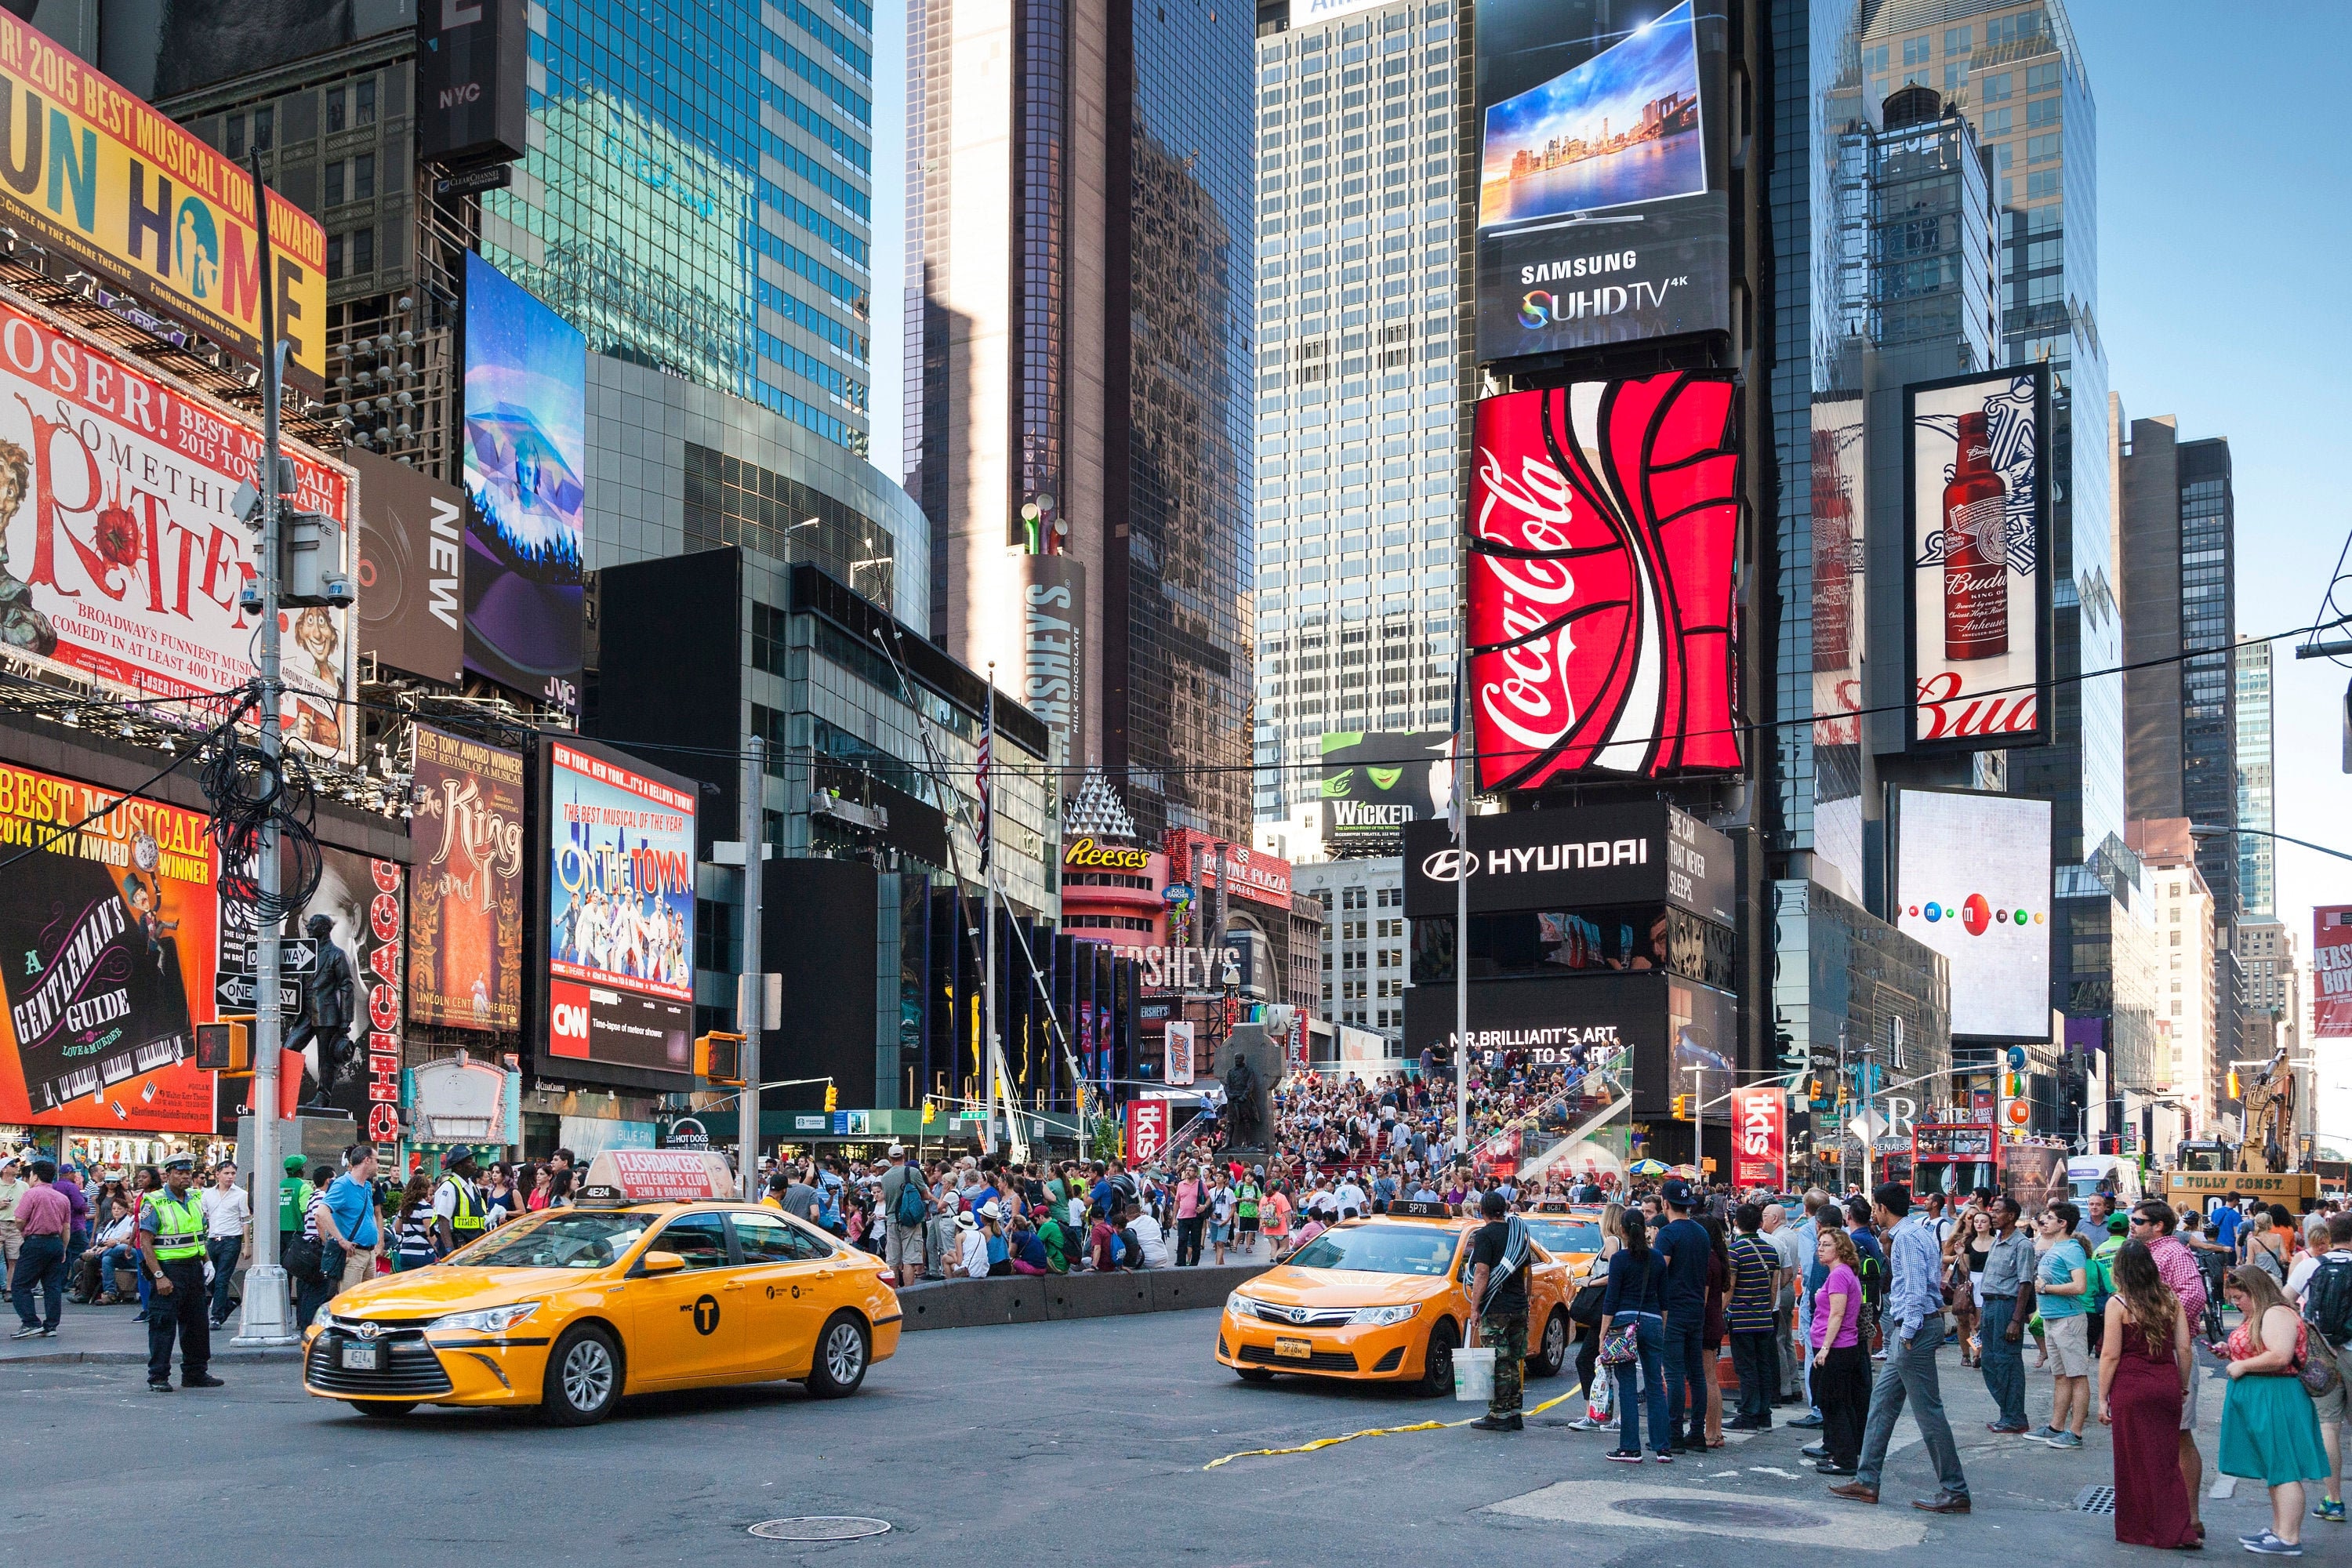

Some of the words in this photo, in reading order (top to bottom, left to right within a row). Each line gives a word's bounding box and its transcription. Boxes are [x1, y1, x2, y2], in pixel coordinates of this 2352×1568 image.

[440, 82, 481, 109] NYC
[29, 37, 78, 107] 2015
[84, 72, 132, 141] BEST
[136, 107, 220, 205] MUSICAL
[220, 160, 256, 224] TON
[267, 198, 322, 266] AWARD
[5, 198, 35, 225] CIRCLE
[38, 219, 45, 234] IN
[49, 227, 64, 242] THE
[65, 234, 96, 263] SQUARE
[98, 253, 132, 281] THEATRE
[1520, 250, 1637, 285] SAMSUNG
[150, 281, 241, 342] FUNHOMEBROADWAY.COM
[178, 403, 233, 449] BEST
[178, 428, 216, 463] 2015
[220, 449, 258, 485] TON
[429, 496, 459, 631] NEW
[1479, 445, 1577, 750] Coca-Cola
[1955, 601, 1976, 610] Brewed
[1976, 601, 1984, 609] by
[1948, 611, 1969, 619] Choicest
[52, 614, 108, 645] COMEDY
[111, 636, 125, 651] IN
[128, 641, 144, 658] AT
[147, 646, 183, 672] LEAST
[187, 662, 208, 681] 400
[211, 667, 248, 691] YEAR
[81, 652, 97, 662] OFFICIAL
[161, 633, 219, 666] FUNNIEST
[281, 666, 303, 684] AROUND
[303, 679, 314, 691] THE
[314, 684, 336, 704] CORNER
[544, 676, 575, 706] JVC
[307, 695, 326, 710] STREET
[418, 729, 437, 750] 2015
[438, 735, 459, 756] TONY
[460, 742, 489, 764] AWARD
[491, 751, 523, 775] WINNER!
[418, 746, 437, 760] BEST
[439, 752, 471, 770] REVIVAL
[473, 762, 483, 772] OF
[483, 768, 490, 776] A
[491, 767, 523, 785] MUSICAL
[554, 746, 571, 765] NEW
[572, 751, 591, 776] YORK,
[592, 760, 607, 778] NEW
[644, 781, 649, 796] A
[648, 783, 674, 805] HELLUVA
[674, 793, 693, 812] TOWN!
[0, 767, 74, 828] BEST
[78, 787, 210, 859] MUSICAL!
[431, 778, 524, 878] King
[564, 803, 579, 822] THE
[581, 804, 601, 824] BEST
[603, 808, 637, 828] MUSICAL
[639, 811, 649, 829] OF
[650, 813, 664, 832] THE
[666, 815, 684, 833] YEAR
[1331, 800, 1414, 826] WICKED
[1669, 809, 1682, 838] THE
[1682, 816, 1695, 845] CAR
[0, 820, 33, 850] 2014
[38, 826, 76, 857] TONY
[79, 833, 129, 868] AWARD
[158, 851, 209, 886] WINNER
[1065, 837, 1151, 871] Reese's
[1489, 838, 1647, 876] HYUNDAI
[1669, 839, 1686, 869] THAT
[1686, 848, 1705, 880] NEVER
[439, 869, 474, 903] and
[477, 850, 498, 915] I
[557, 844, 596, 895] ON
[630, 847, 689, 898] TOWN
[1250, 868, 1287, 892] PLAZA
[1669, 869, 1693, 903] SLEEPS.
[1229, 883, 1255, 898] HOTEL
[223, 929, 236, 939] THE
[13, 895, 126, 1046] GENTLEMAN'S
[25, 949, 44, 976] A
[223, 952, 231, 961] IN
[282, 949, 307, 963] WAY
[568, 965, 586, 978] THEATRE
[227, 983, 252, 999] ONE
[368, 857, 401, 1142] CHICAGO
[416, 992, 450, 1008] LINCOLN
[66, 987, 131, 1033] GUIDE
[553, 1003, 587, 1039] CNN
[592, 1018, 621, 1033] Time-lapse
[621, 1022, 627, 1033] of
[626, 1024, 644, 1036] meteor
[644, 1026, 663, 1039] shower
[1582, 1025, 1617, 1043] ART
[1888, 1014, 1907, 1070] R
[1533, 1047, 1555, 1064] TO
[1744, 1093, 1776, 1156] tkts
[1885, 1097, 1916, 1138] R
[1974, 1106, 1994, 1117] JERSEY
[618, 1129, 637, 1142] BLUE
[640, 1131, 652, 1142] FIN
[675, 1134, 689, 1143] HOT
[689, 1133, 709, 1143] DOGS
[1137, 1105, 1161, 1159] tkts
[88, 1138, 165, 1164] GRAND
[617, 1152, 705, 1174] FLASHDANCERS
[586, 1187, 610, 1198] 4E24
[623, 1173, 684, 1186] GENTLEMEN'S
[686, 1174, 709, 1186] CLUB
[636, 1186, 655, 1198] 52ND
[656, 1187, 663, 1198] &
[664, 1188, 702, 1198] BROADWAY
[2187, 1176, 2228, 1189] TULLY
[2235, 1177, 2285, 1190] CONST.
[457, 1217, 477, 1227] TIMES
[1408, 1203, 1428, 1214] 5P78
[163, 1236, 181, 1246] NY
[679, 1304, 693, 1312] NYC
[699, 1302, 714, 1330] T
